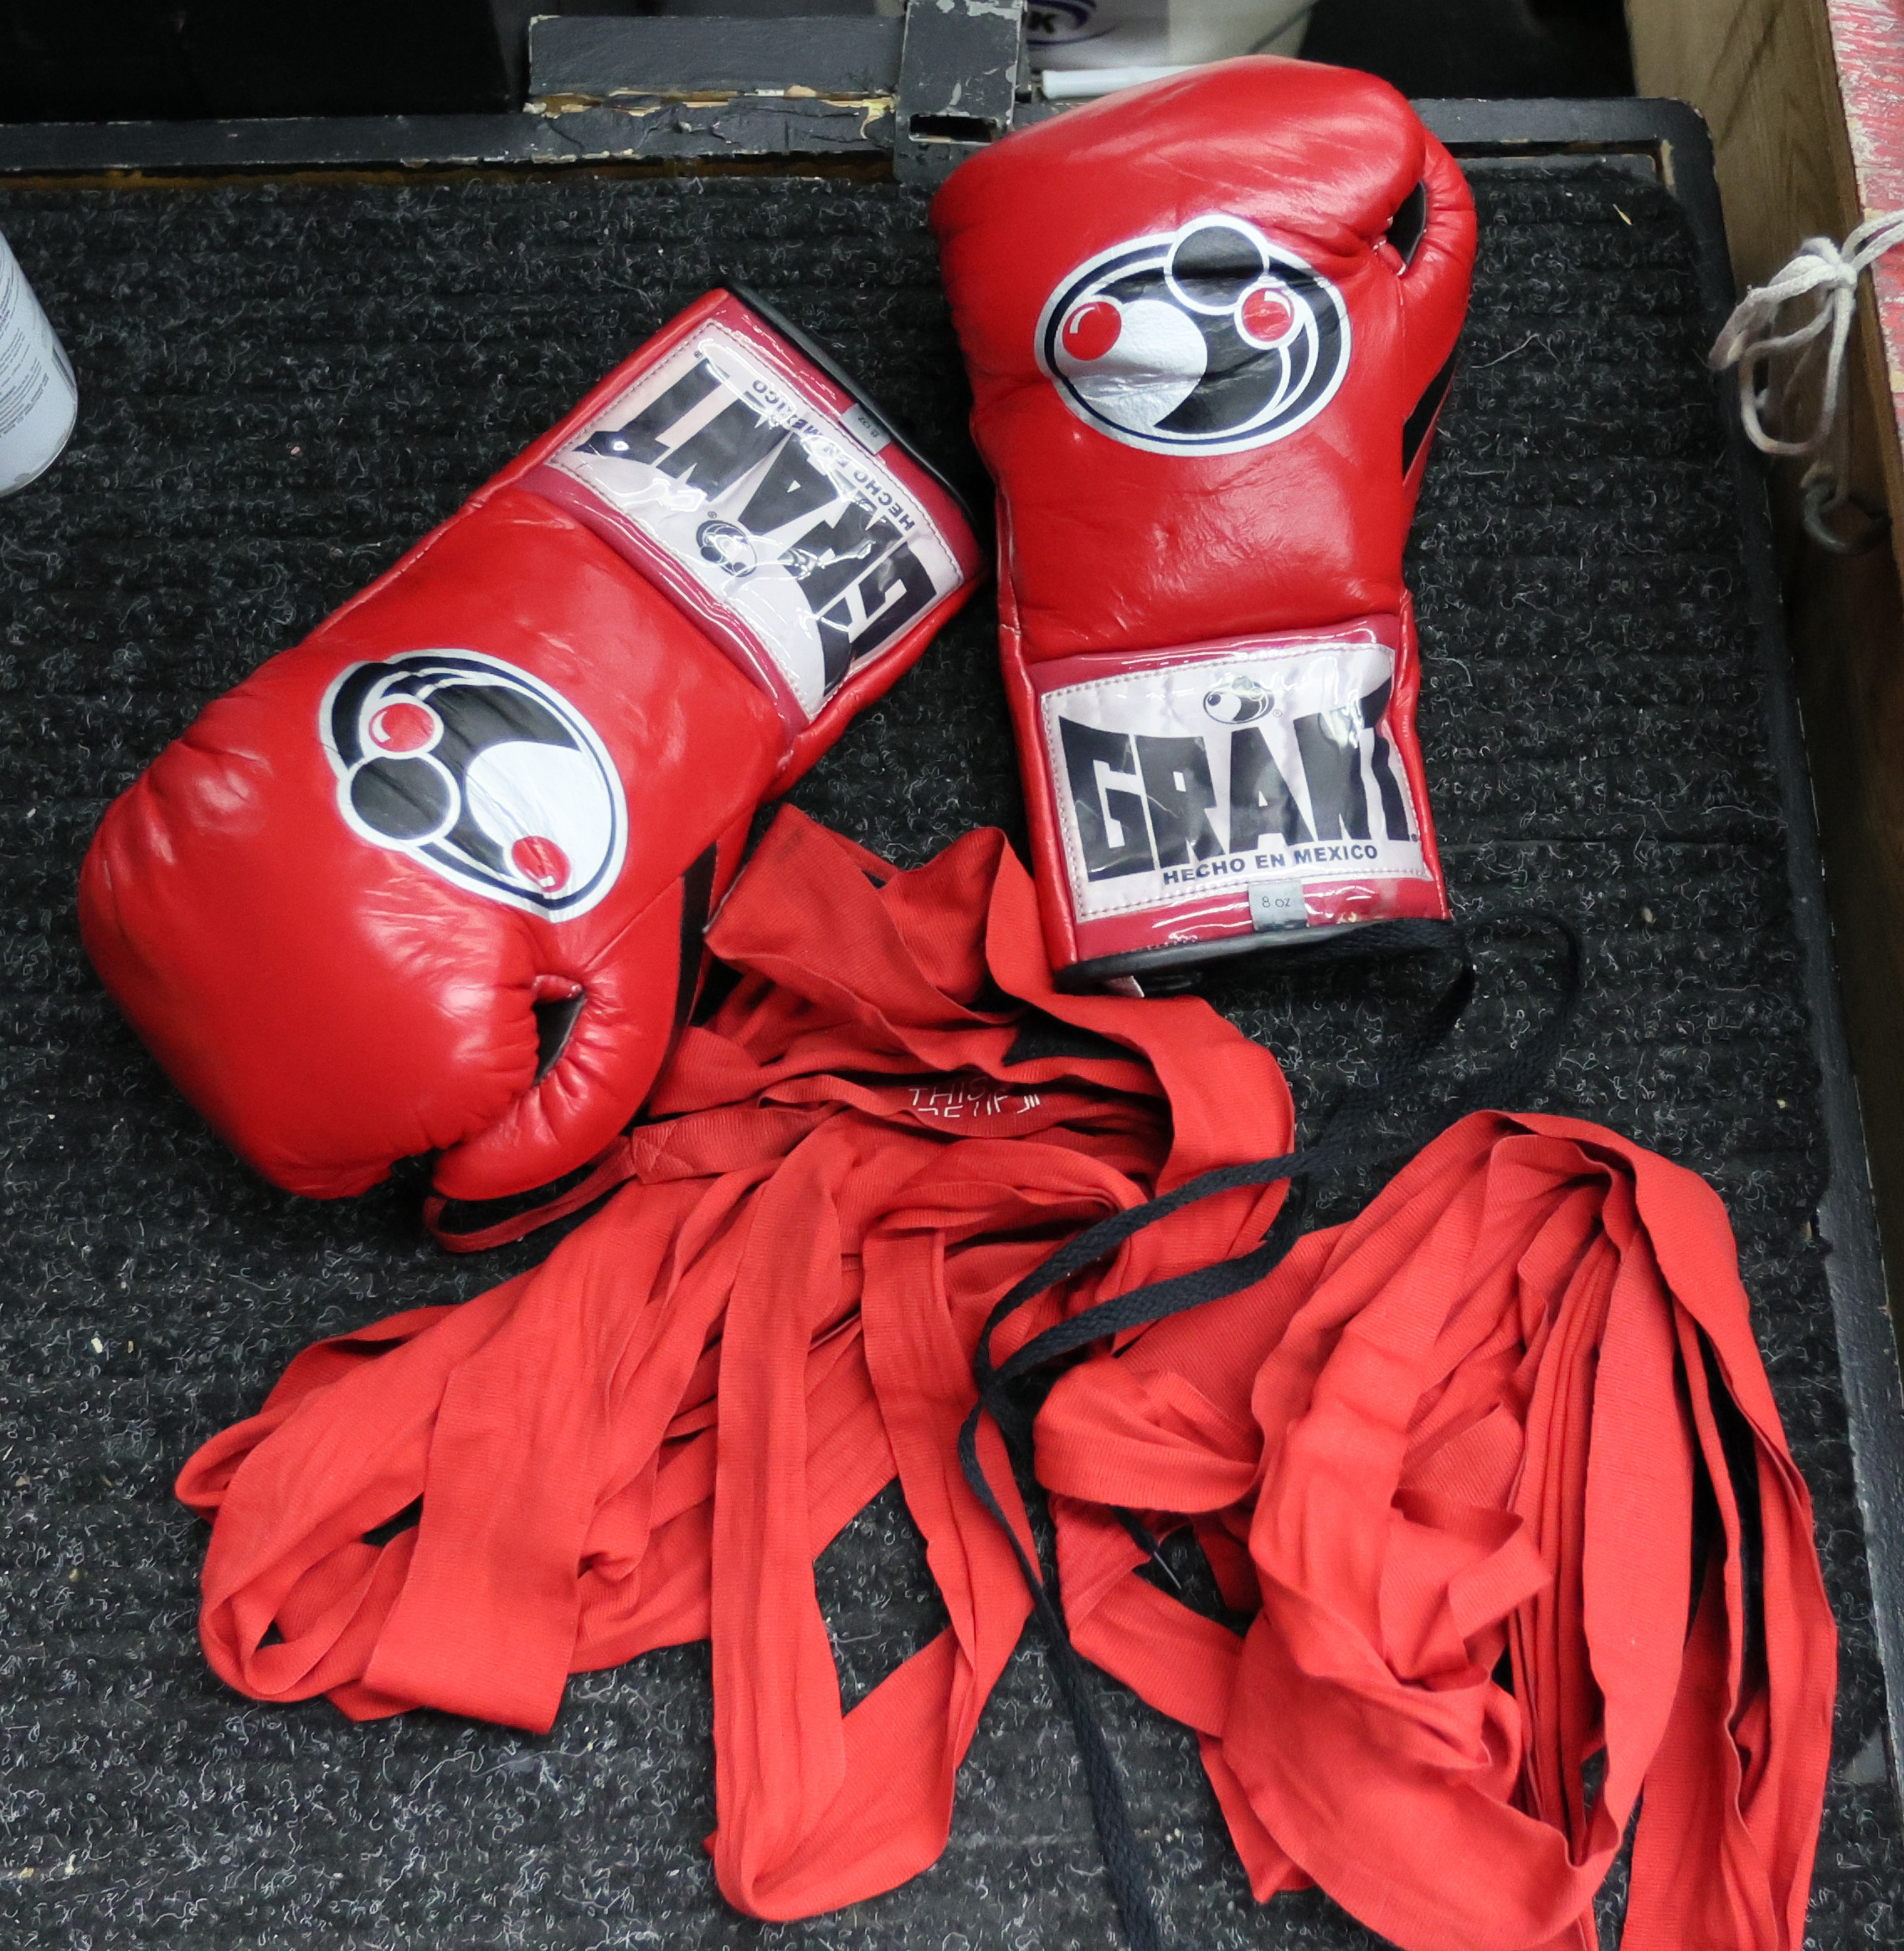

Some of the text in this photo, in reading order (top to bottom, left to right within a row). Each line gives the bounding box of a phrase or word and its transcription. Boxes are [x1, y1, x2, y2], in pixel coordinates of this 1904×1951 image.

[822, 443, 849, 470] EN
[853, 469, 916, 531] HECHO
[573, 358, 937, 697] GRANT
[1163, 844, 1376, 886] HECHO EN MEXICO
[1262, 896, 1271, 909] 8
